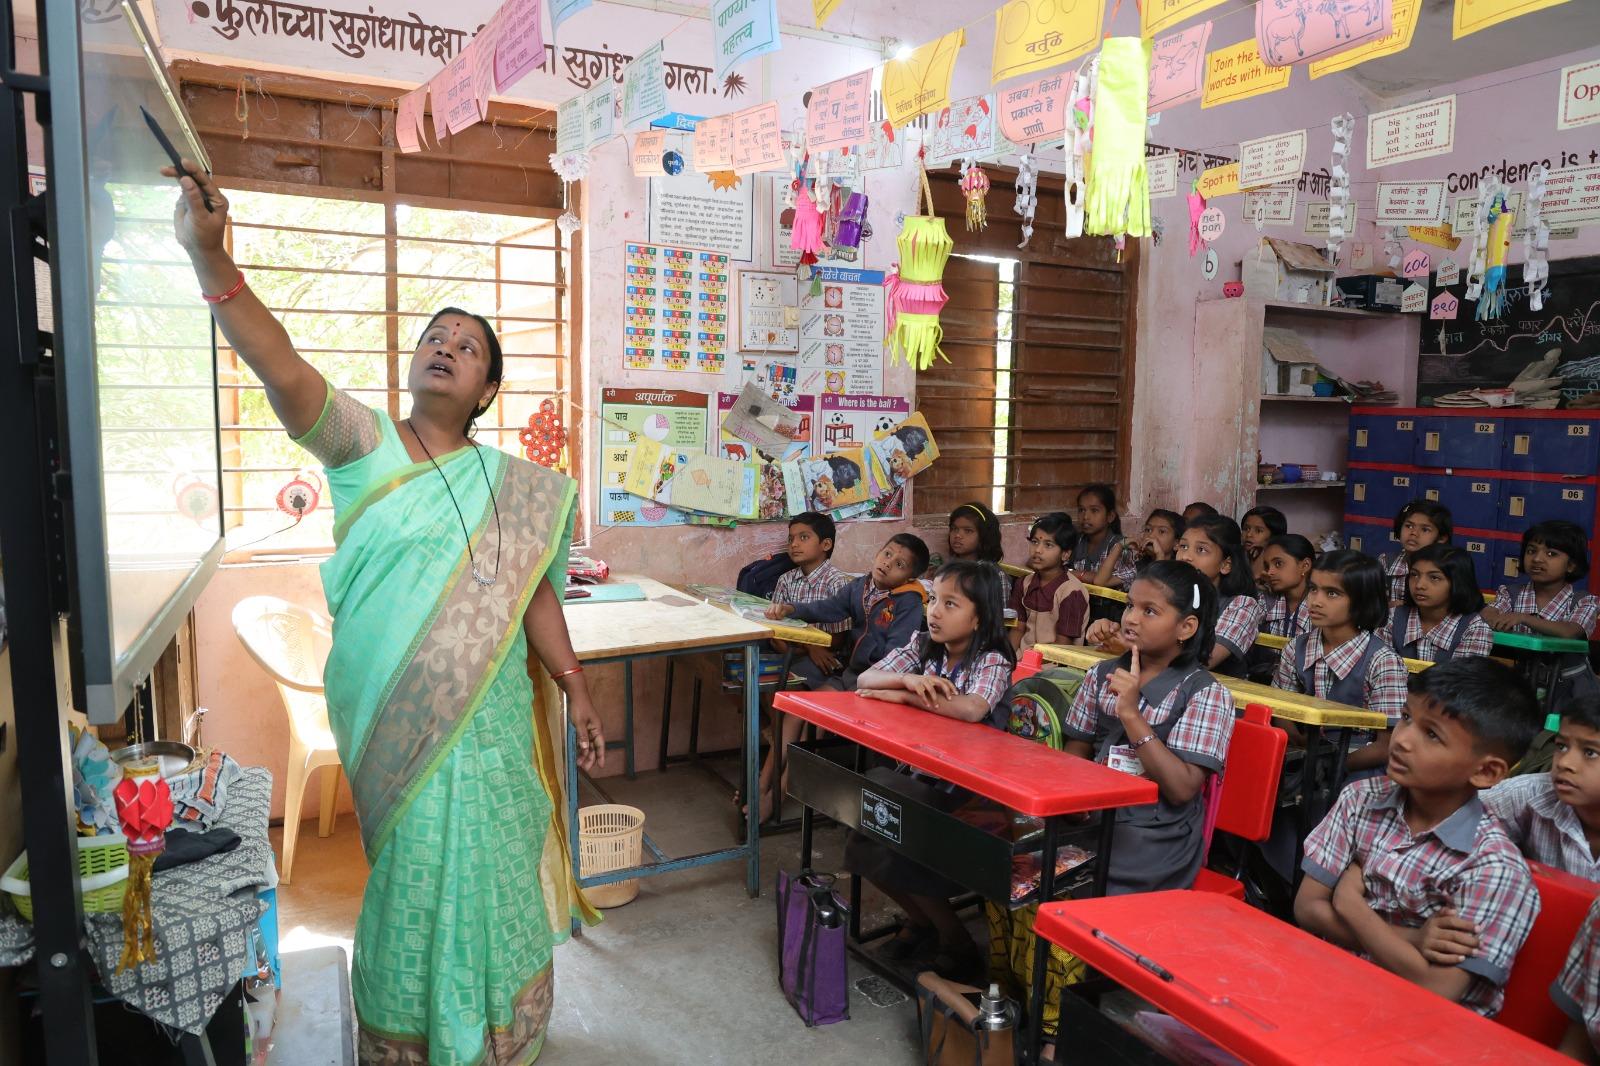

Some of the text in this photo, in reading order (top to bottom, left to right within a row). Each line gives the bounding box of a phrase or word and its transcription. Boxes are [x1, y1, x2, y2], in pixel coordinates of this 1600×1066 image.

[1214, 56, 1233, 73] Join
[1237, 51, 1253, 65] the
[1209, 73, 1237, 91] words
[1240, 65, 1261, 82] with
[1388, 108, 1440, 128] big small
[1387, 119, 1437, 137] tall short
[1385, 129, 1435, 146] soft hard
[1248, 140, 1290, 155] clean dirty
[1387, 138, 1434, 154] hot cold
[1275, 148, 1285, 157] dry
[1274, 154, 1299, 164] smooth
[1273, 164, 1285, 173] old
[1203, 171, 1238, 190] Spot th
[1203, 214, 1221, 222] net
[1202, 223, 1221, 234] pan
[838, 397, 858, 407] Where
[859, 398, 866, 407] is
[866, 398, 877, 407] the
[1401, 421, 1409, 429] 01
[1479, 424, 1490, 432] 02
[1573, 426, 1584, 435] 03
[1397, 478, 1406, 486] 04
[1476, 483, 1486, 492] 05
[1567, 490, 1579, 499] 06
[1471, 542, 1481, 551] 08
